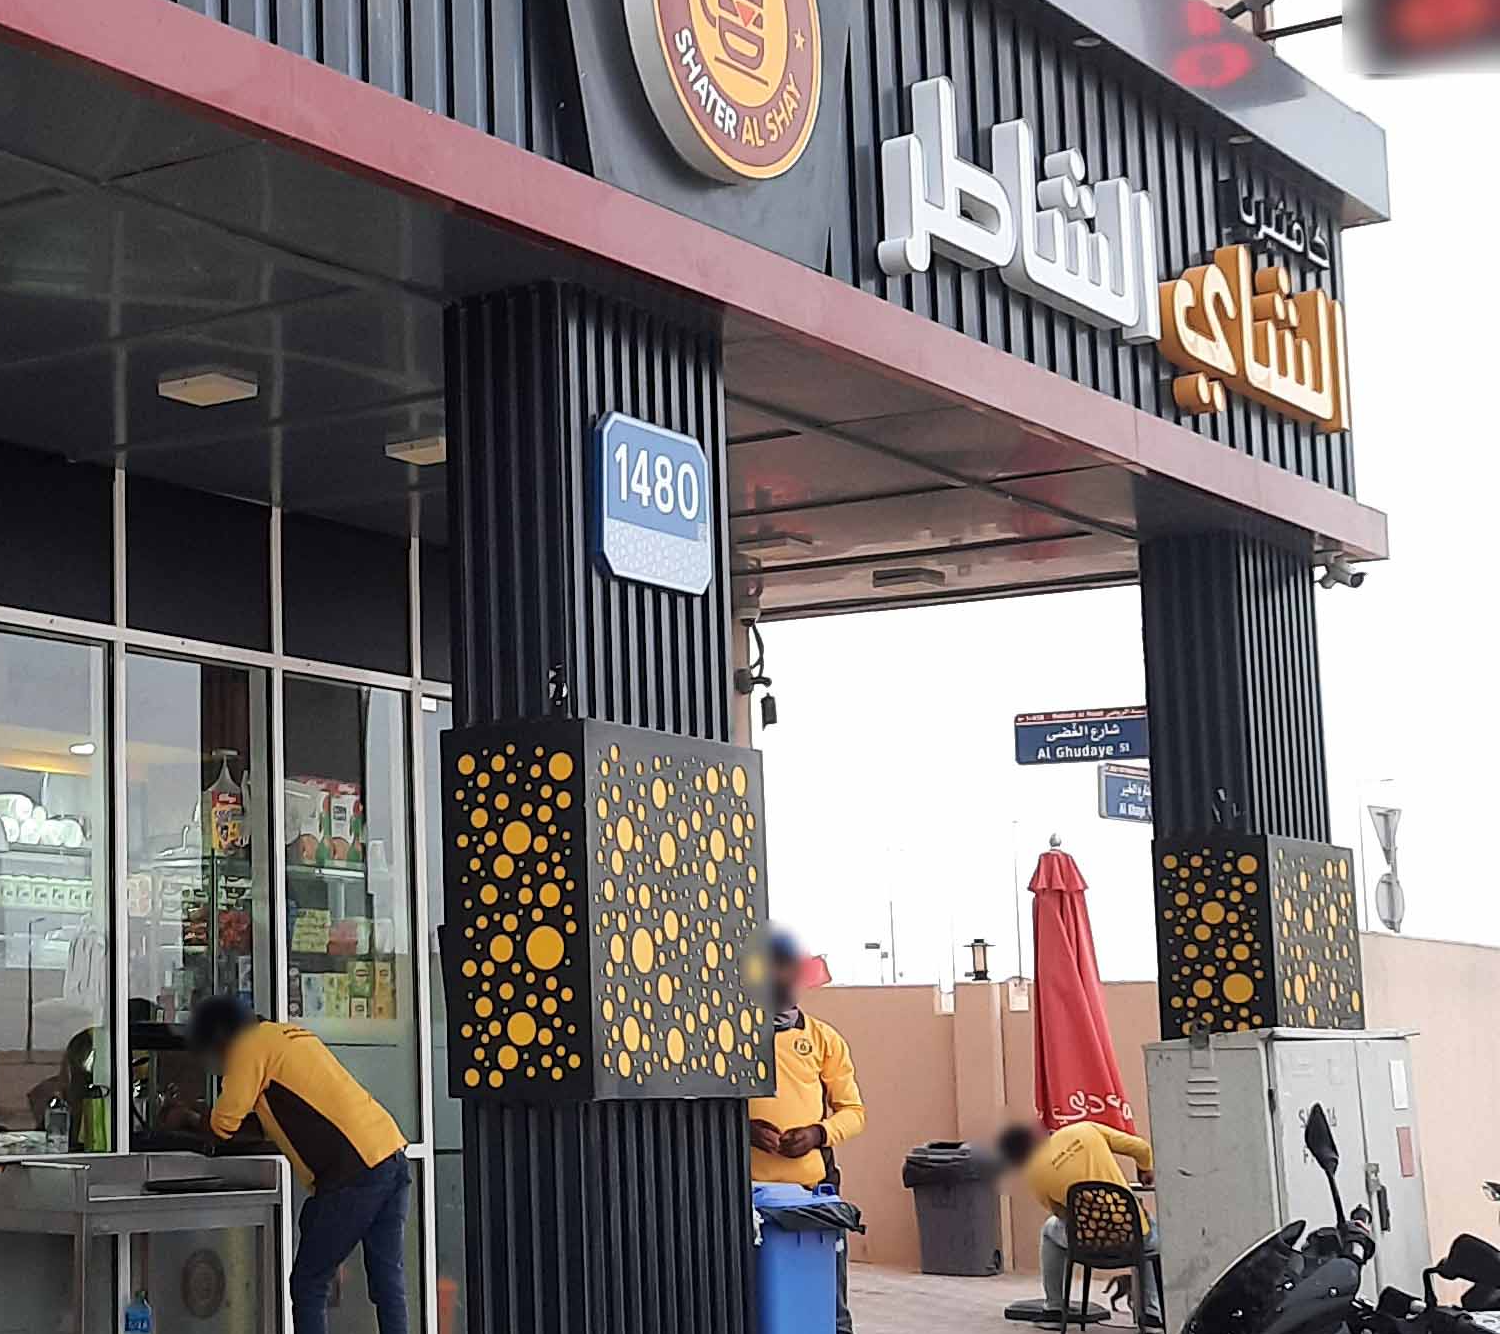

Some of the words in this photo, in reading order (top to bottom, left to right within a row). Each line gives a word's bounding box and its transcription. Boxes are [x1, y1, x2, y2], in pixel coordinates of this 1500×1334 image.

[674, 28, 738, 139] SHATER
[740, 114, 766, 147] AL
[766, 71, 803, 144] SHAY
[878, 75, 1162, 345] الشاطر
[1159, 244, 1351, 434] الشاي
[614, 442, 700, 521] 1480
[1037, 748, 1051, 760] Al
[1056, 743, 1114, 759] Ghudaye
[1090, 722, 1121, 742] شارع
